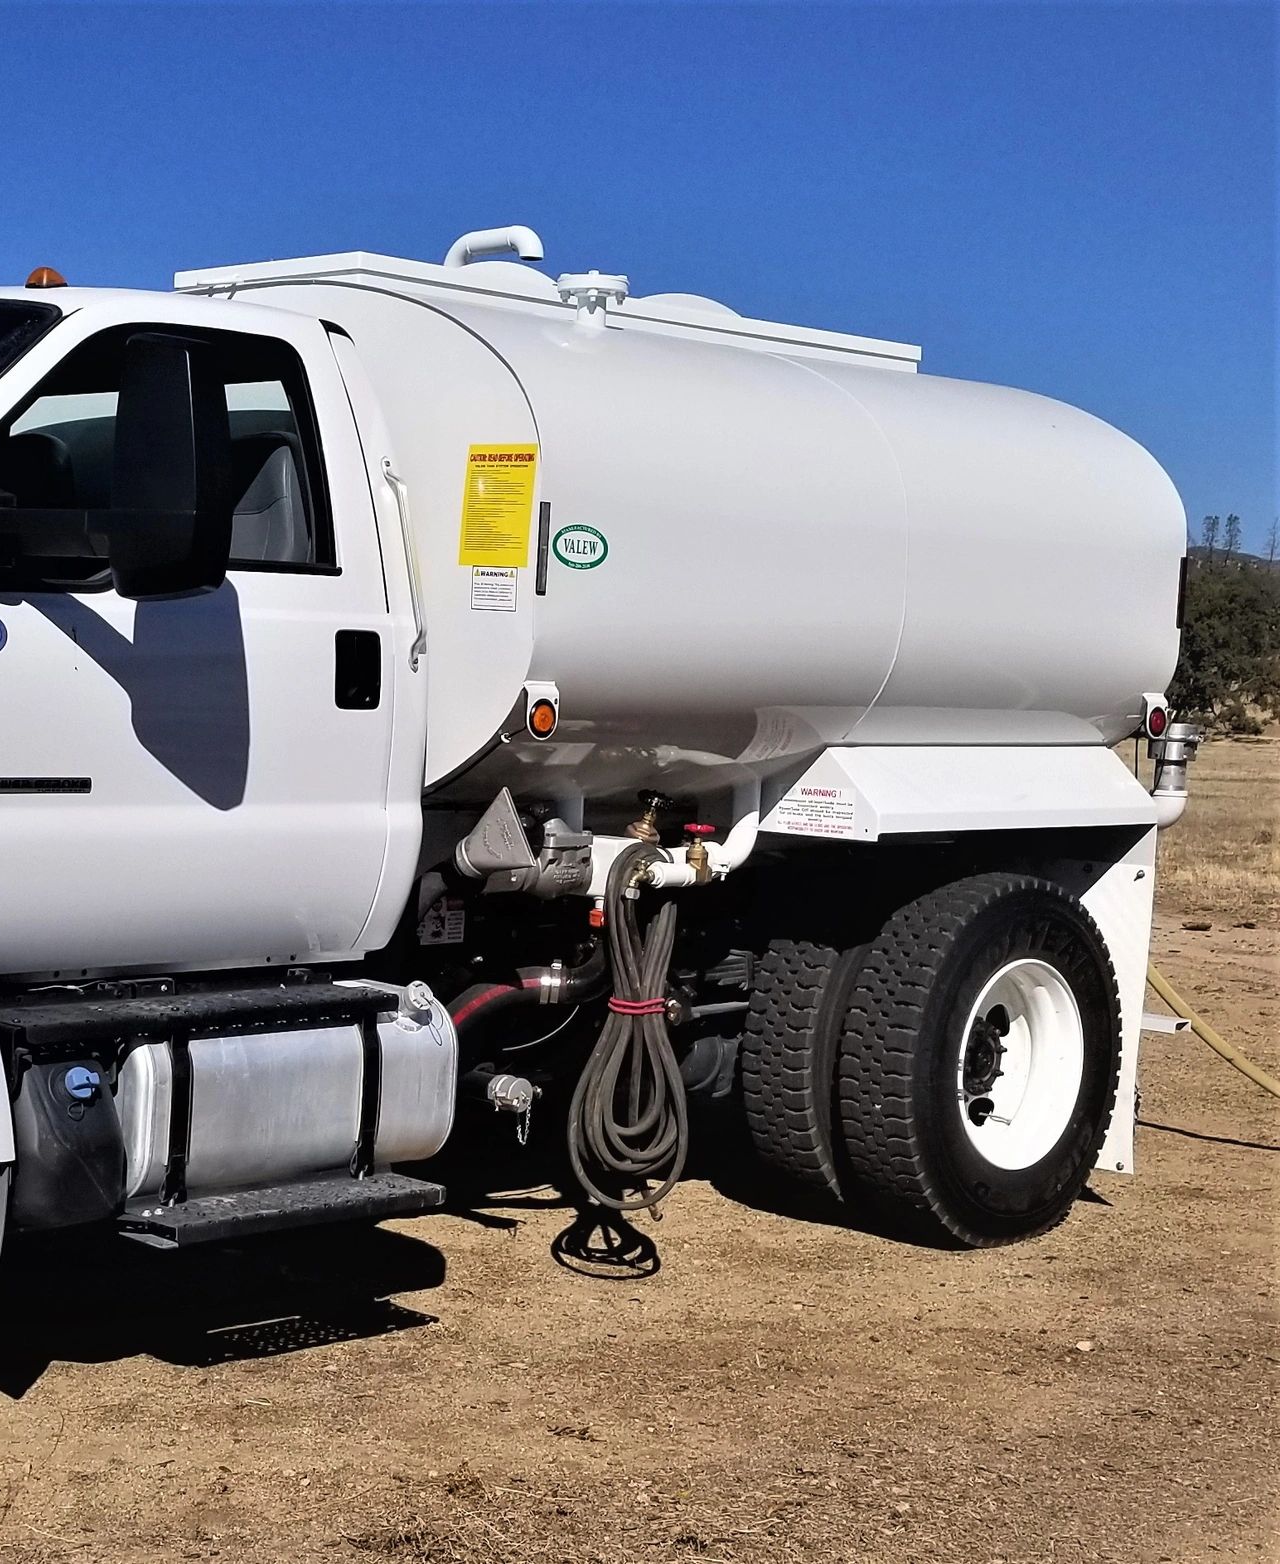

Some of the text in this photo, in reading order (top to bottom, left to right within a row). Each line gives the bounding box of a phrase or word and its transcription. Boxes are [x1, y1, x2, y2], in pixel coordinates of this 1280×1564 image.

[563, 538, 599, 556] VALEW
[480, 570, 509, 578] WARNING
[800, 787, 837, 798] WARNING
